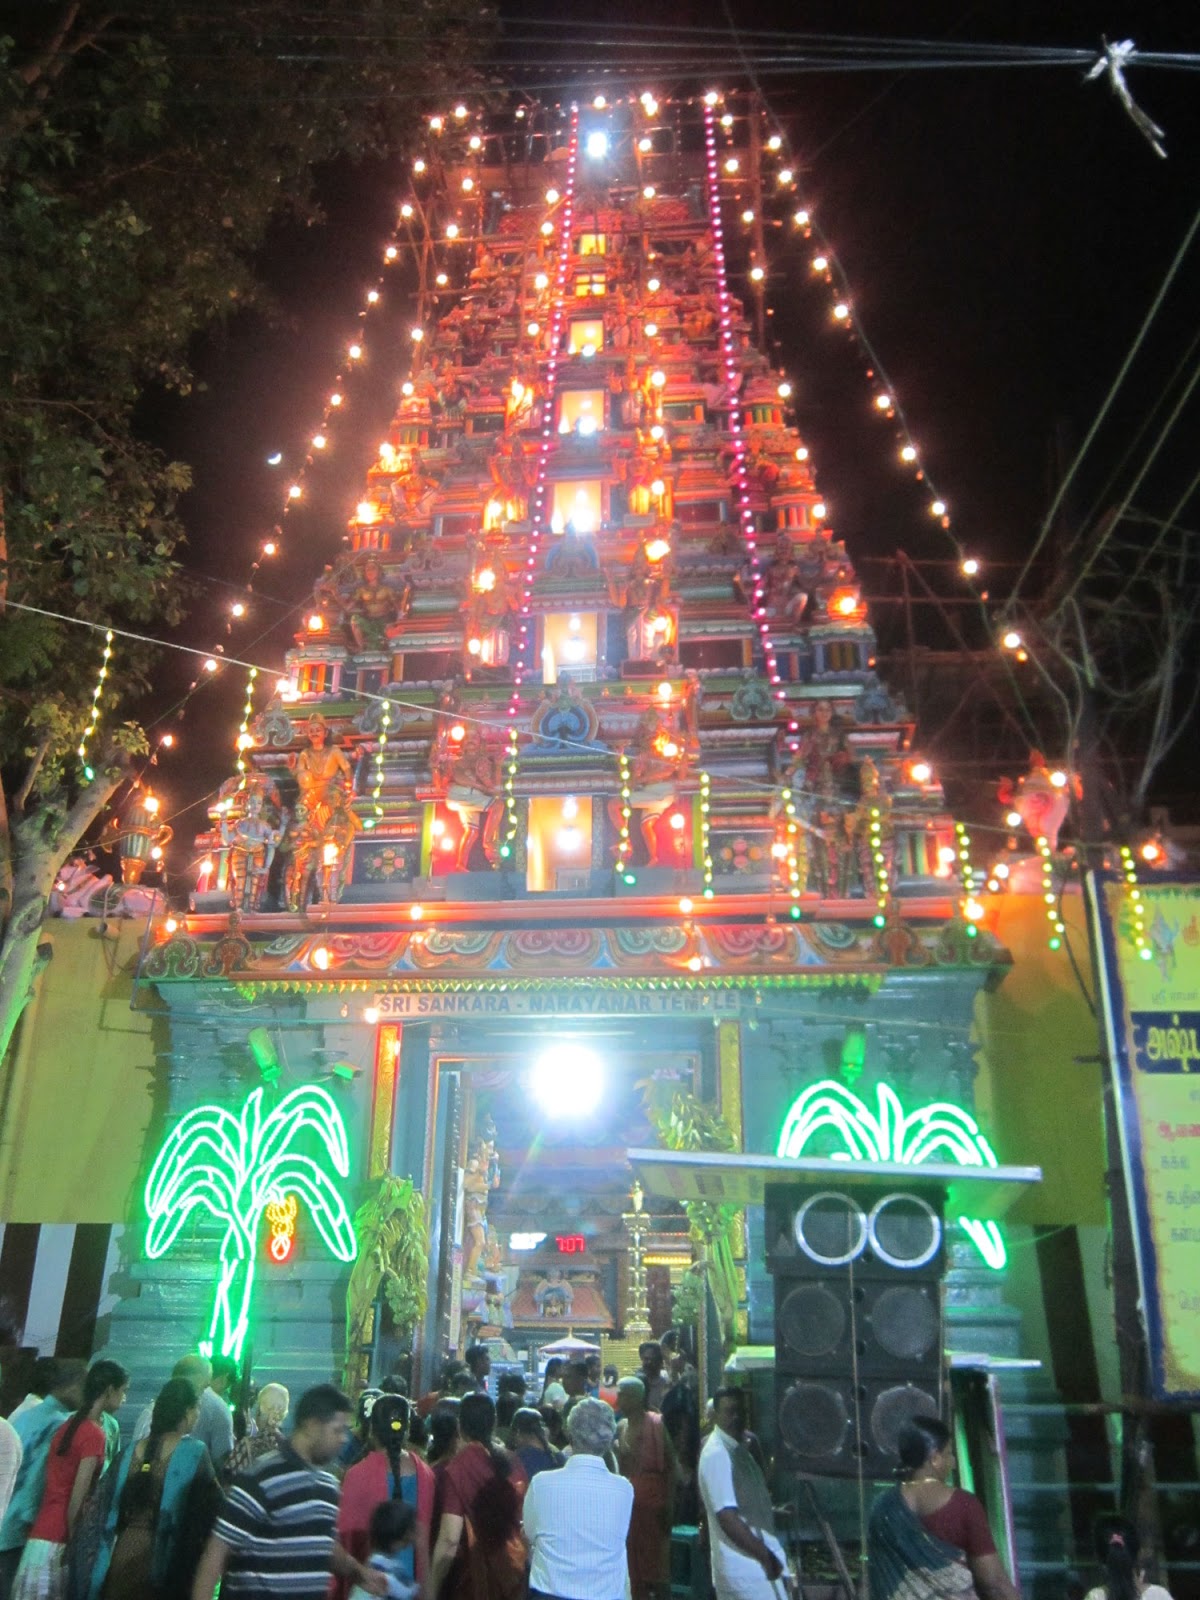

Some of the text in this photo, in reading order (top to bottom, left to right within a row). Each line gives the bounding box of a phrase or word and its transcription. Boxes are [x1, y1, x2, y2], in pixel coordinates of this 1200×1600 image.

[380, 996, 411, 1013] SRI
[417, 995, 511, 1012] SANKARA
[529, 994, 651, 1011] NARAYANAR
[555, 1236, 584, 1252] 7:07
